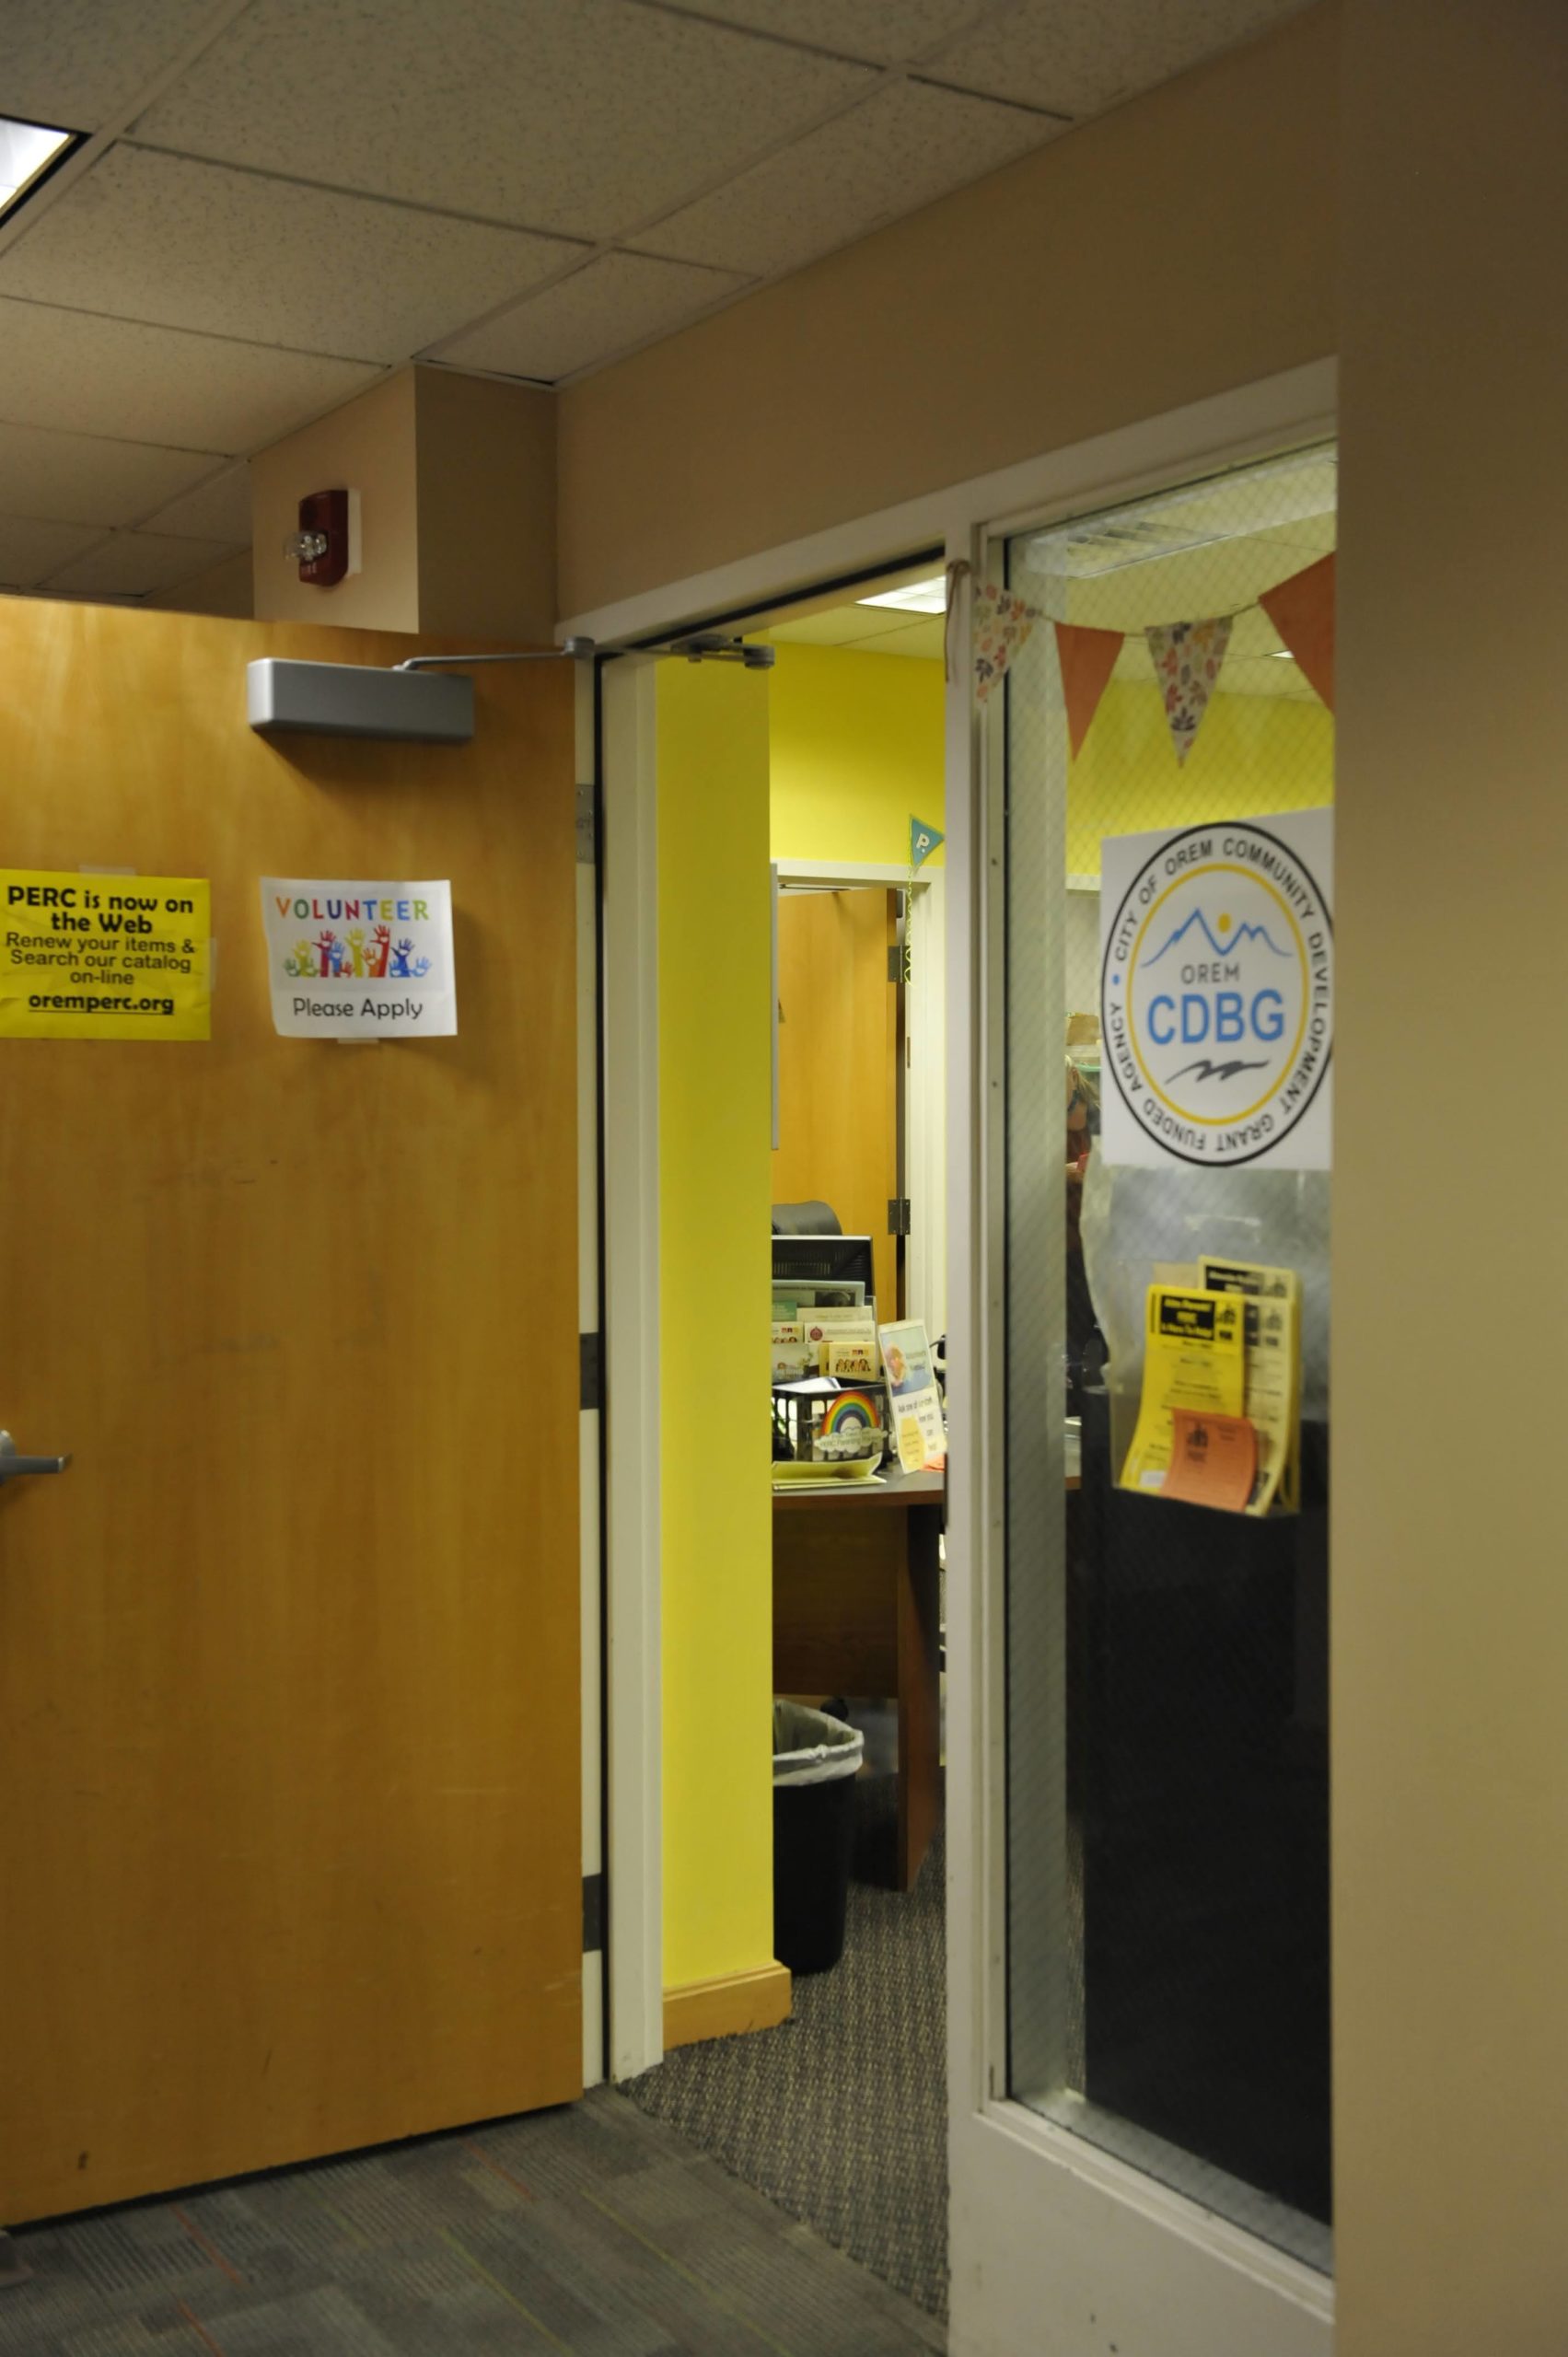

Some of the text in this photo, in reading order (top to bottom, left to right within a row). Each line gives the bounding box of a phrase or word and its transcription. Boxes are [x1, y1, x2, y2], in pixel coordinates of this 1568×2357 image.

[7, 886, 193, 913] PERC is now on
[276, 897, 429, 921] VOLUNTEER
[52, 911, 153, 934] the Web
[6, 932, 195, 954] Renew your items &
[10, 949, 192, 973] Search our catalog
[70, 970, 134, 985] on-line
[1180, 962, 1240, 984] OREM
[29, 994, 175, 1015] oremperc.org
[1110, 838, 1329, 1151] CITY OF OREM COMMUNITY DEVELOPMENT GRANT FUNDED AGENCY
[293, 998, 424, 1019] Please Apply
[1147, 988, 1285, 1045] CDBG
